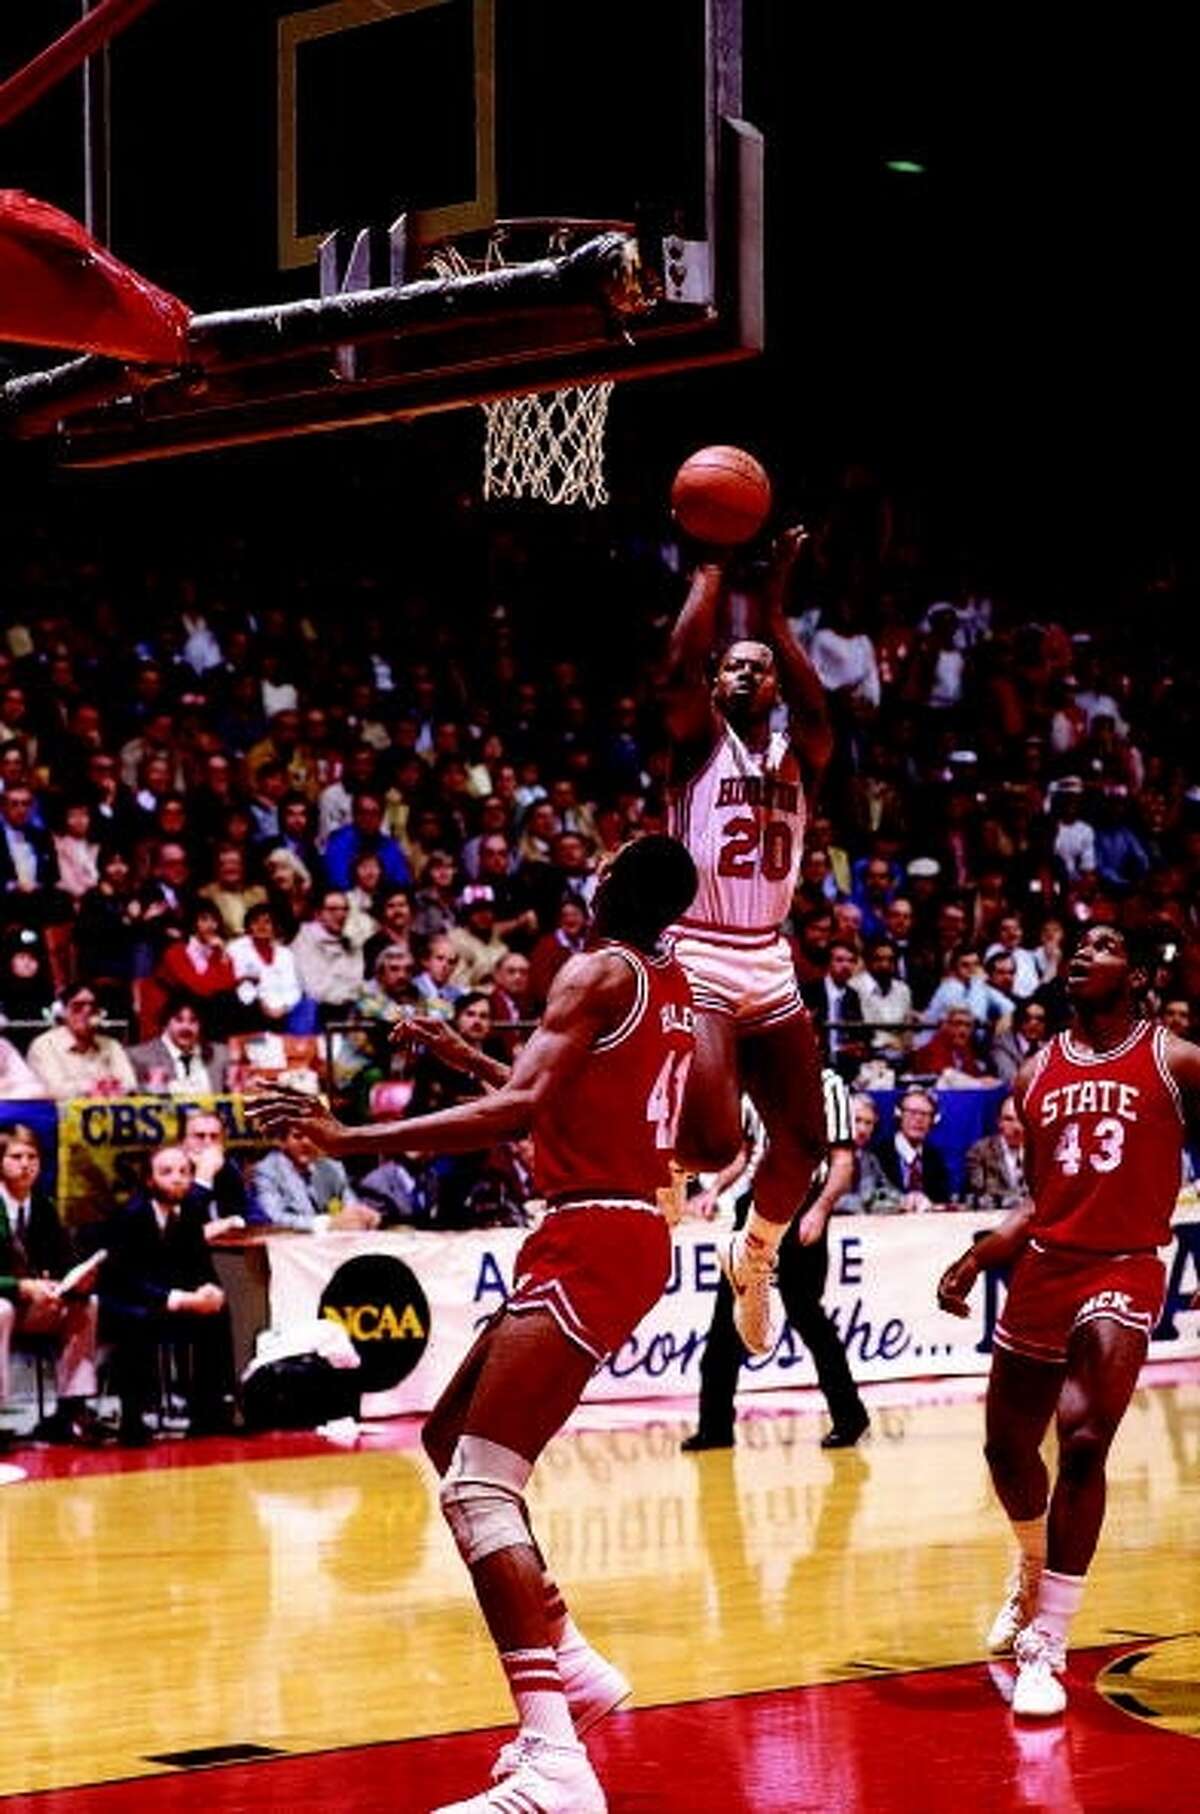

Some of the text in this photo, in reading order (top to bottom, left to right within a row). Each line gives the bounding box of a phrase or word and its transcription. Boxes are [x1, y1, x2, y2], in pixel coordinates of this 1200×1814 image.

[718, 816, 791, 881] 20
[82, 1104, 166, 1146] CBS
[1041, 1080, 1140, 1126] STATE
[1055, 1118, 1126, 1176] 43
[323, 1303, 425, 1341] NCAA
[829, 1299, 952, 1361] he...
